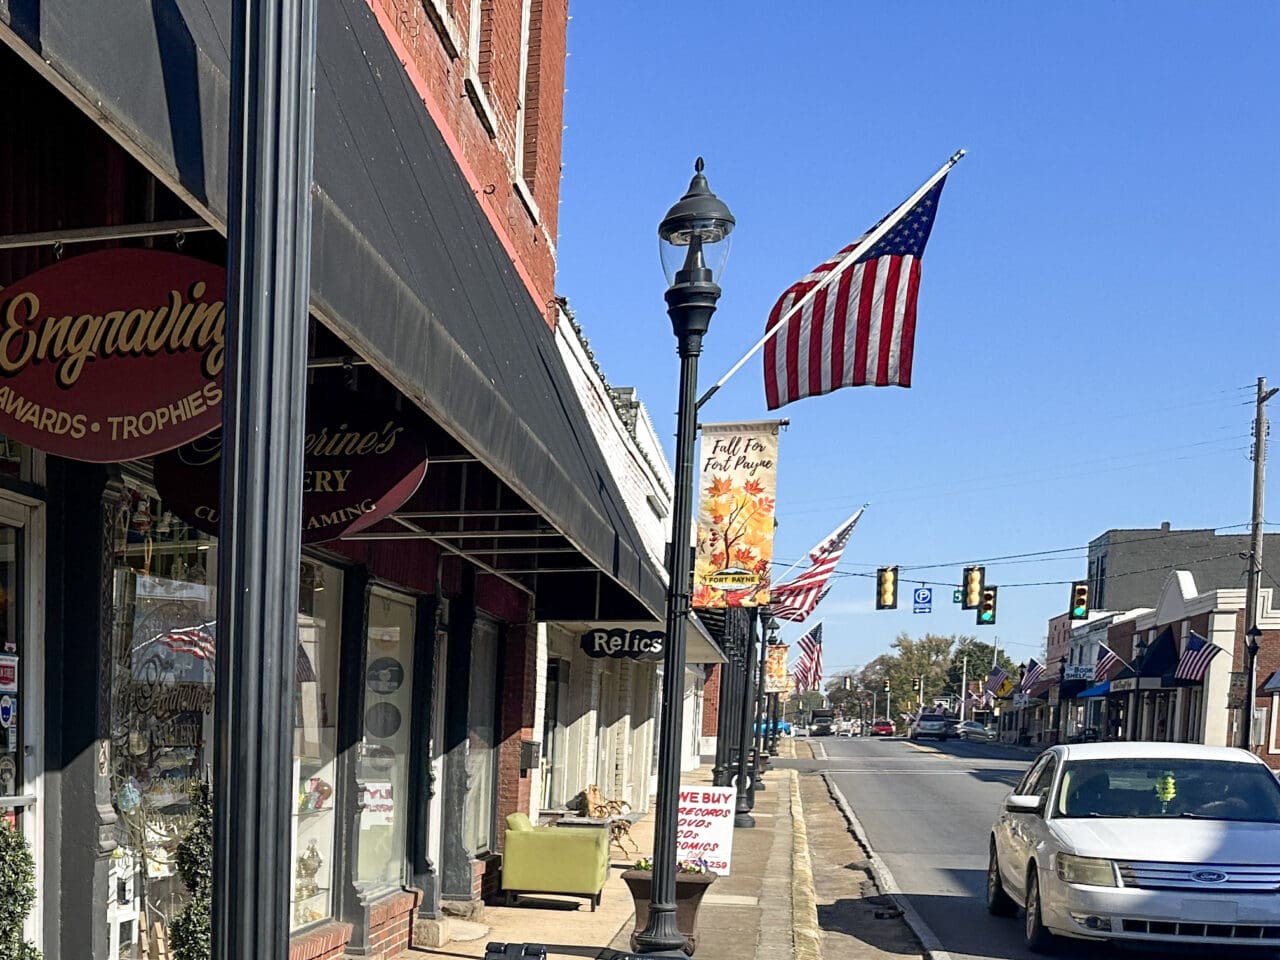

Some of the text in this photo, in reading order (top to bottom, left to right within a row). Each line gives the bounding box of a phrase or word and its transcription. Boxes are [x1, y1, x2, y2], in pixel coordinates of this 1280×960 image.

[107, 381, 223, 441] TROPHIES
[712, 436, 767, 456] Fall For
[703, 455, 773, 476] Fort Payne
[302, 498, 377, 531] AMING
[708, 576, 729, 584] FORT
[593, 632, 663, 655] Relics
[702, 792, 732, 804] BUY
[677, 807, 731, 817] RECORDS
